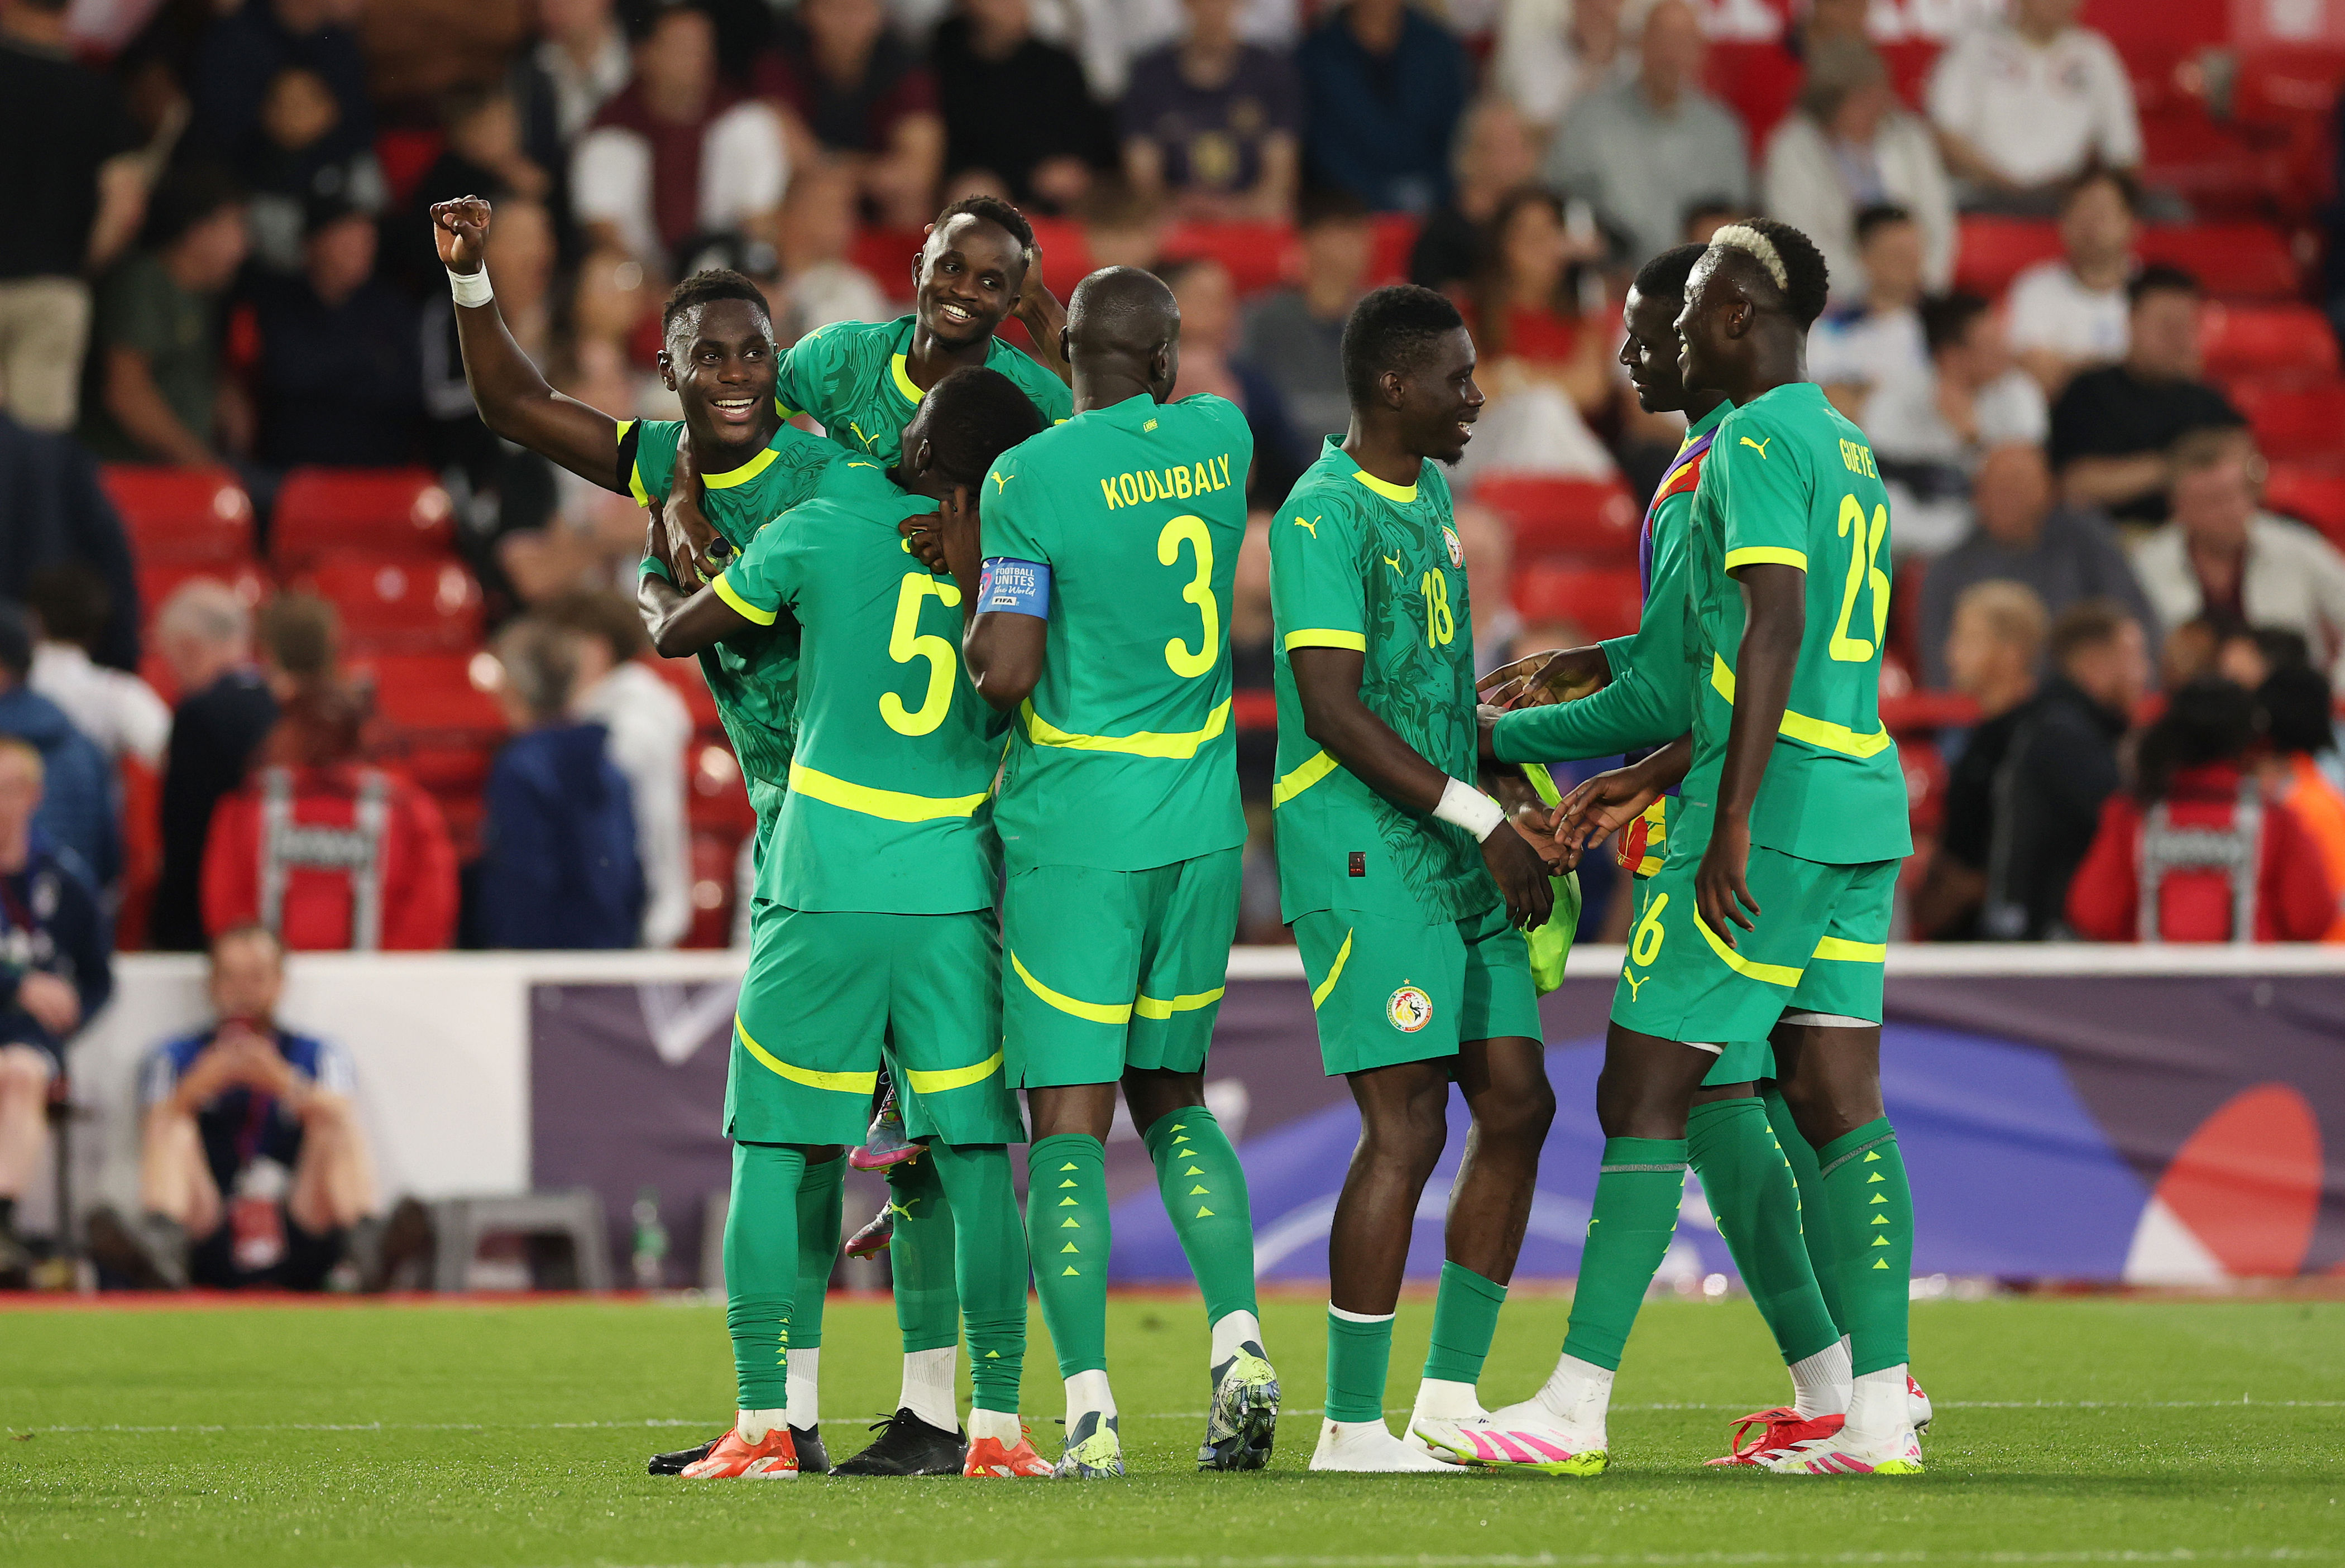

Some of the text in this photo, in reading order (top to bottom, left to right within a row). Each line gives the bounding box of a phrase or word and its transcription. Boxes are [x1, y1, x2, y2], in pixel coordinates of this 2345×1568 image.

[1839, 438, 1875, 479] GUEYE
[994, 585, 1036, 597] the World
[995, 576, 1035, 587] UNITES
[996, 567, 1035, 577] FOOTBALL
[1157, 515, 1218, 678] 3
[1829, 493, 1890, 662] 26
[1421, 568, 1454, 649] 18
[879, 572, 961, 736] 5
